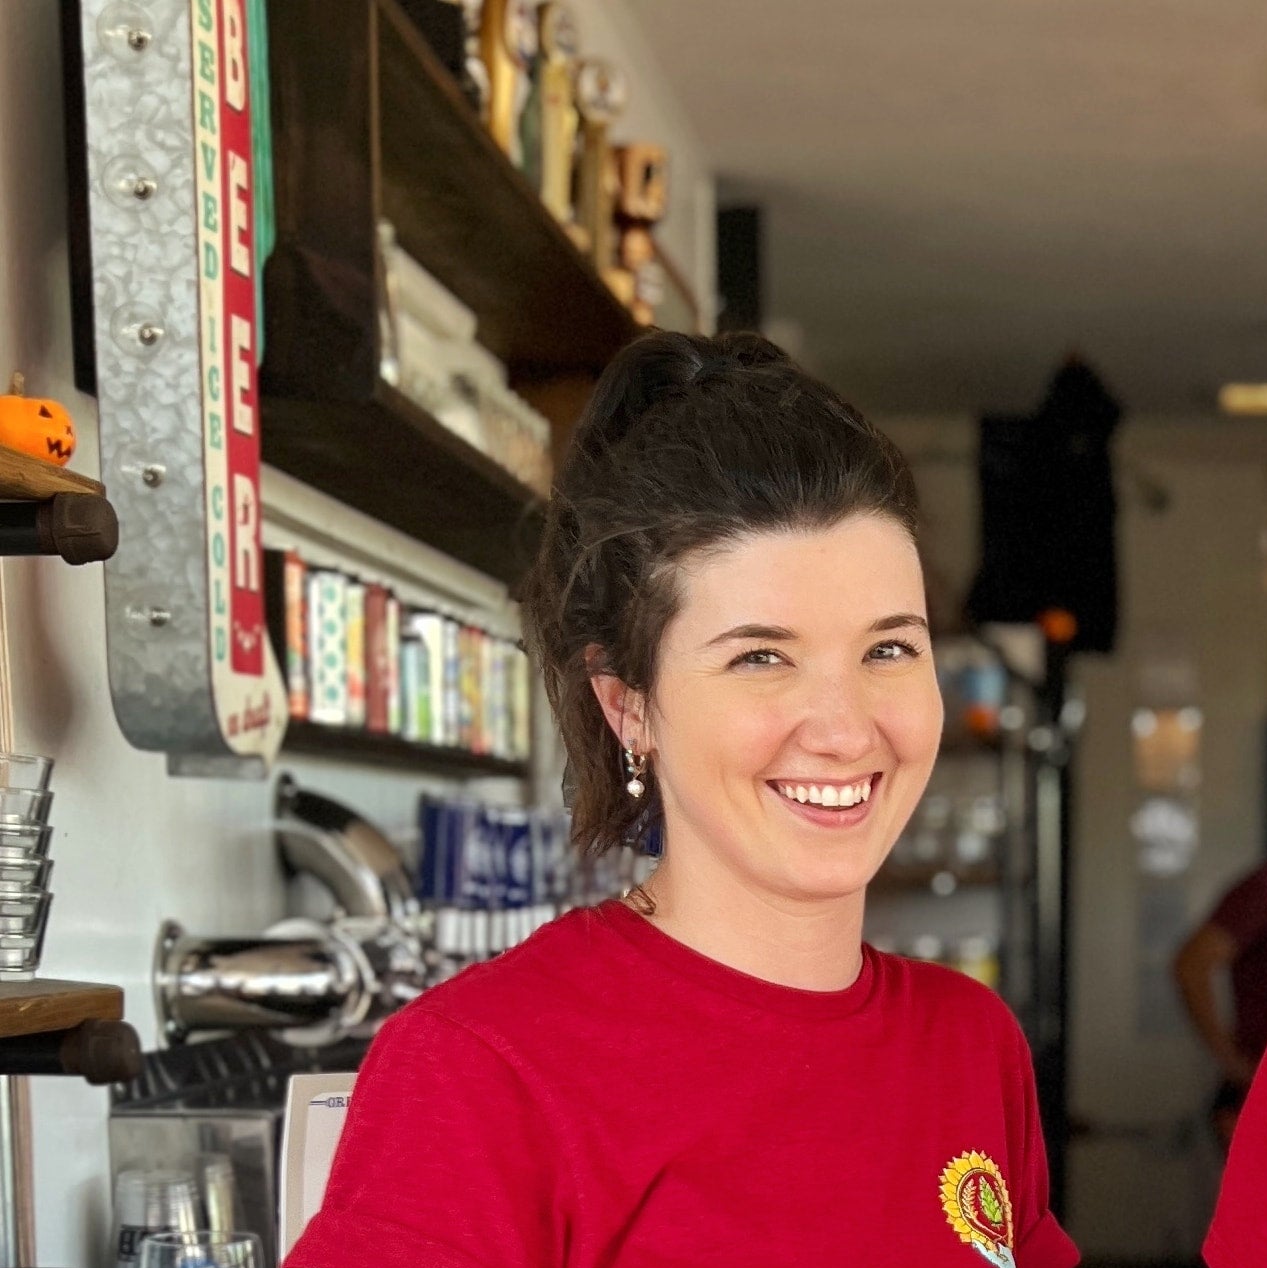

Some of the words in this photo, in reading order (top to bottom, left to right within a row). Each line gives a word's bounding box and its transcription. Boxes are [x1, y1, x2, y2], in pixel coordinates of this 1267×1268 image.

[197, 0, 219, 281] SERVED
[208, 316, 222, 450] ICE
[222, 0, 260, 593] BEER
[211, 484, 226, 662] COLD
